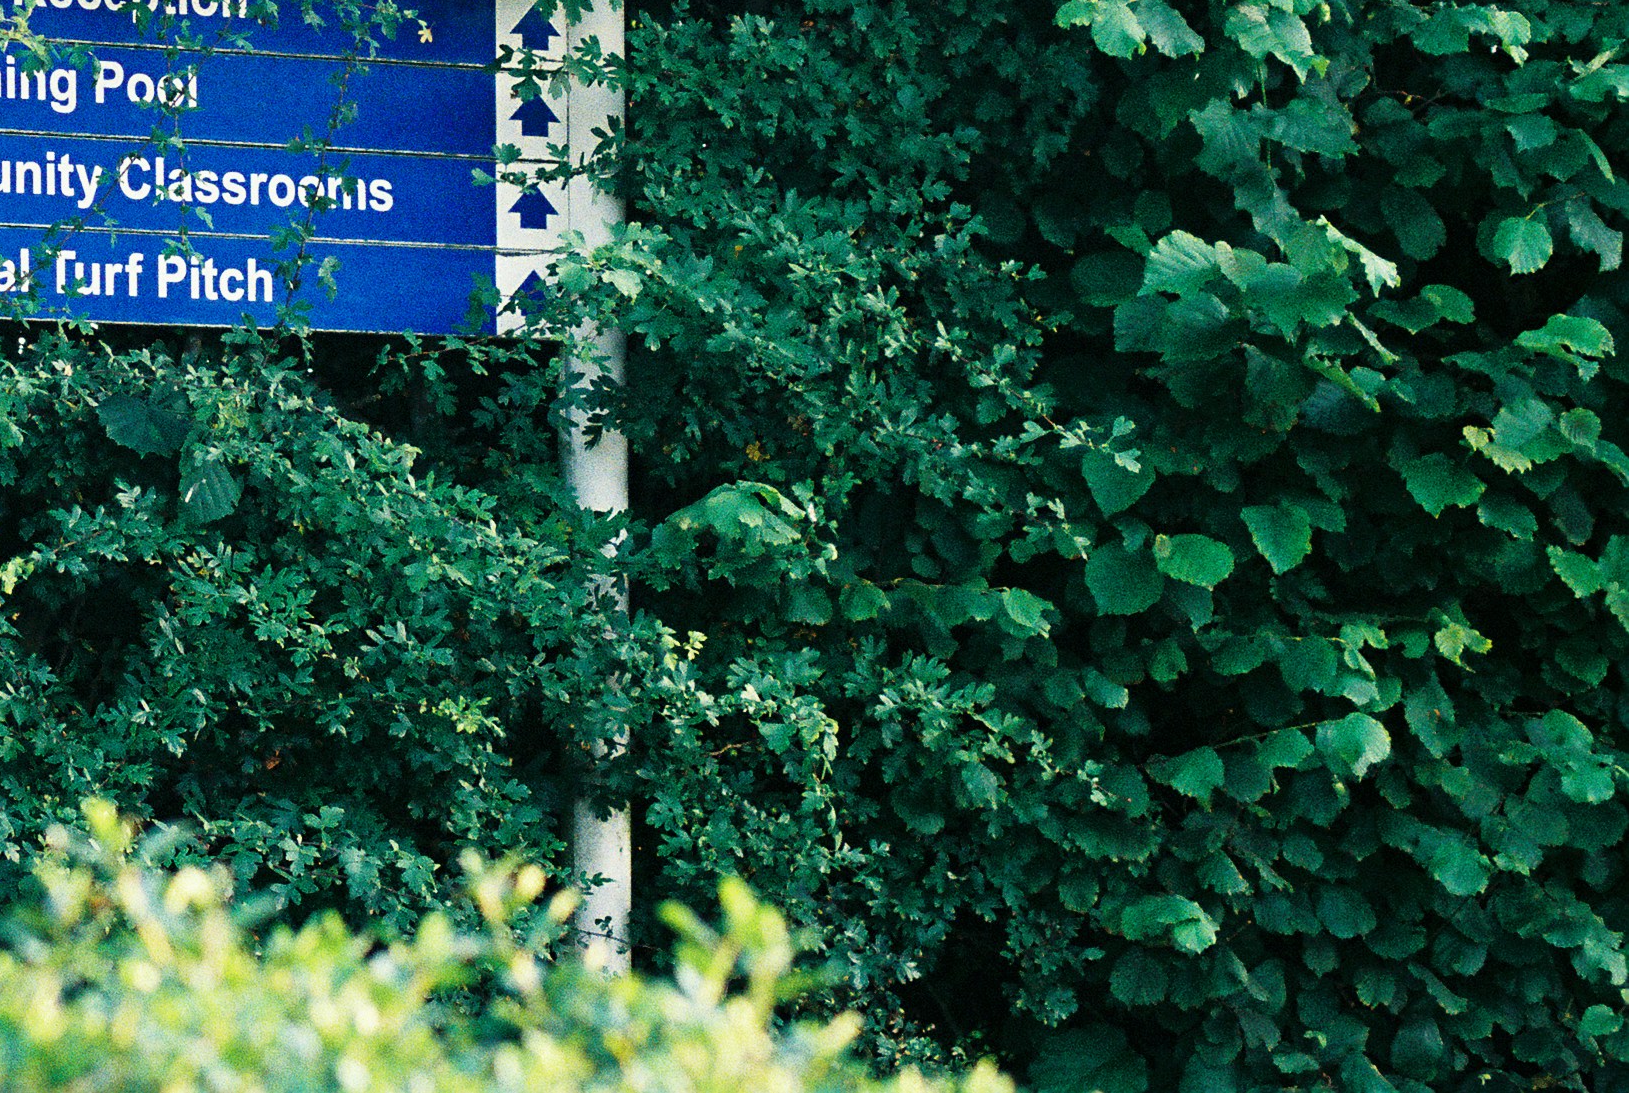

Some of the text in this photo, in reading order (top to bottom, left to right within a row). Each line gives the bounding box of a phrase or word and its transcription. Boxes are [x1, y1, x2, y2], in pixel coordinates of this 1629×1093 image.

[95, 60, 198, 108] Pool
[119, 156, 394, 212] Classrooms
[55, 250, 144, 296] Turf
[157, 252, 274, 302] Pitch
